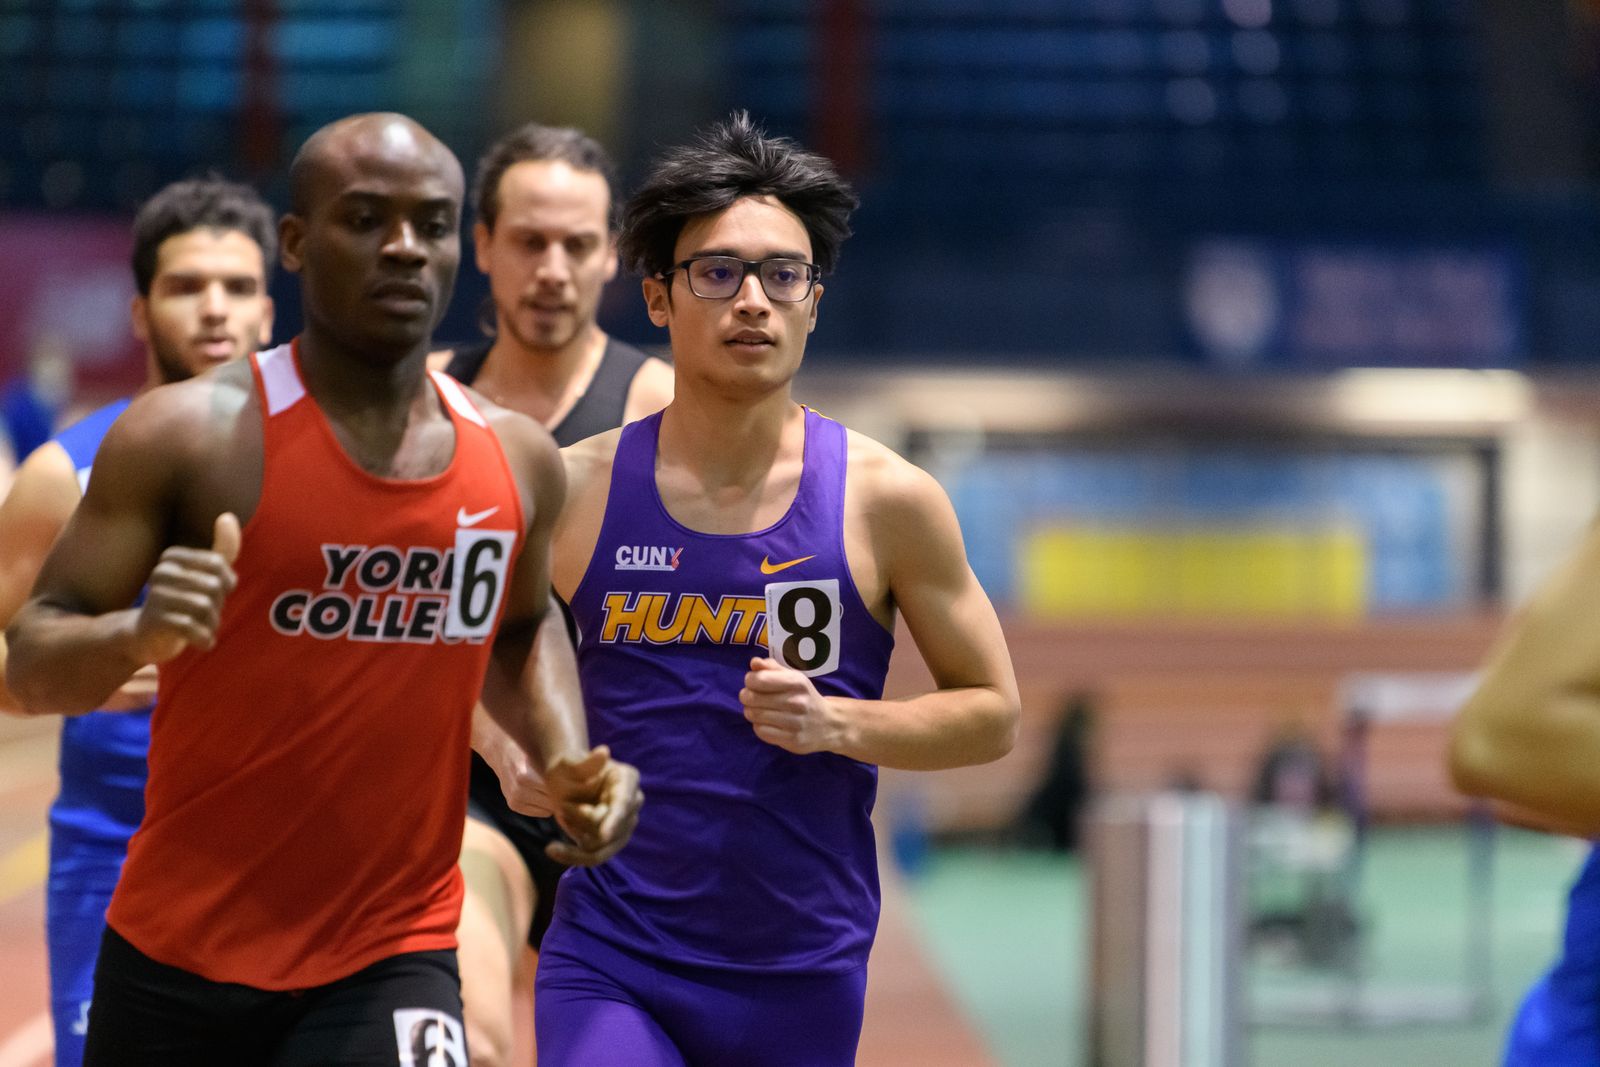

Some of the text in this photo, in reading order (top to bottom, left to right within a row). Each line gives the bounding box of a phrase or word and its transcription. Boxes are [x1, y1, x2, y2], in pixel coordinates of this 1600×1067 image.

[320, 544, 455, 593] YOR
[460, 539, 503, 628] 6
[615, 545, 684, 569] CUNY
[269, 589, 488, 645] COLLE
[600, 592, 768, 649] HUNT
[778, 587, 832, 671] 8
